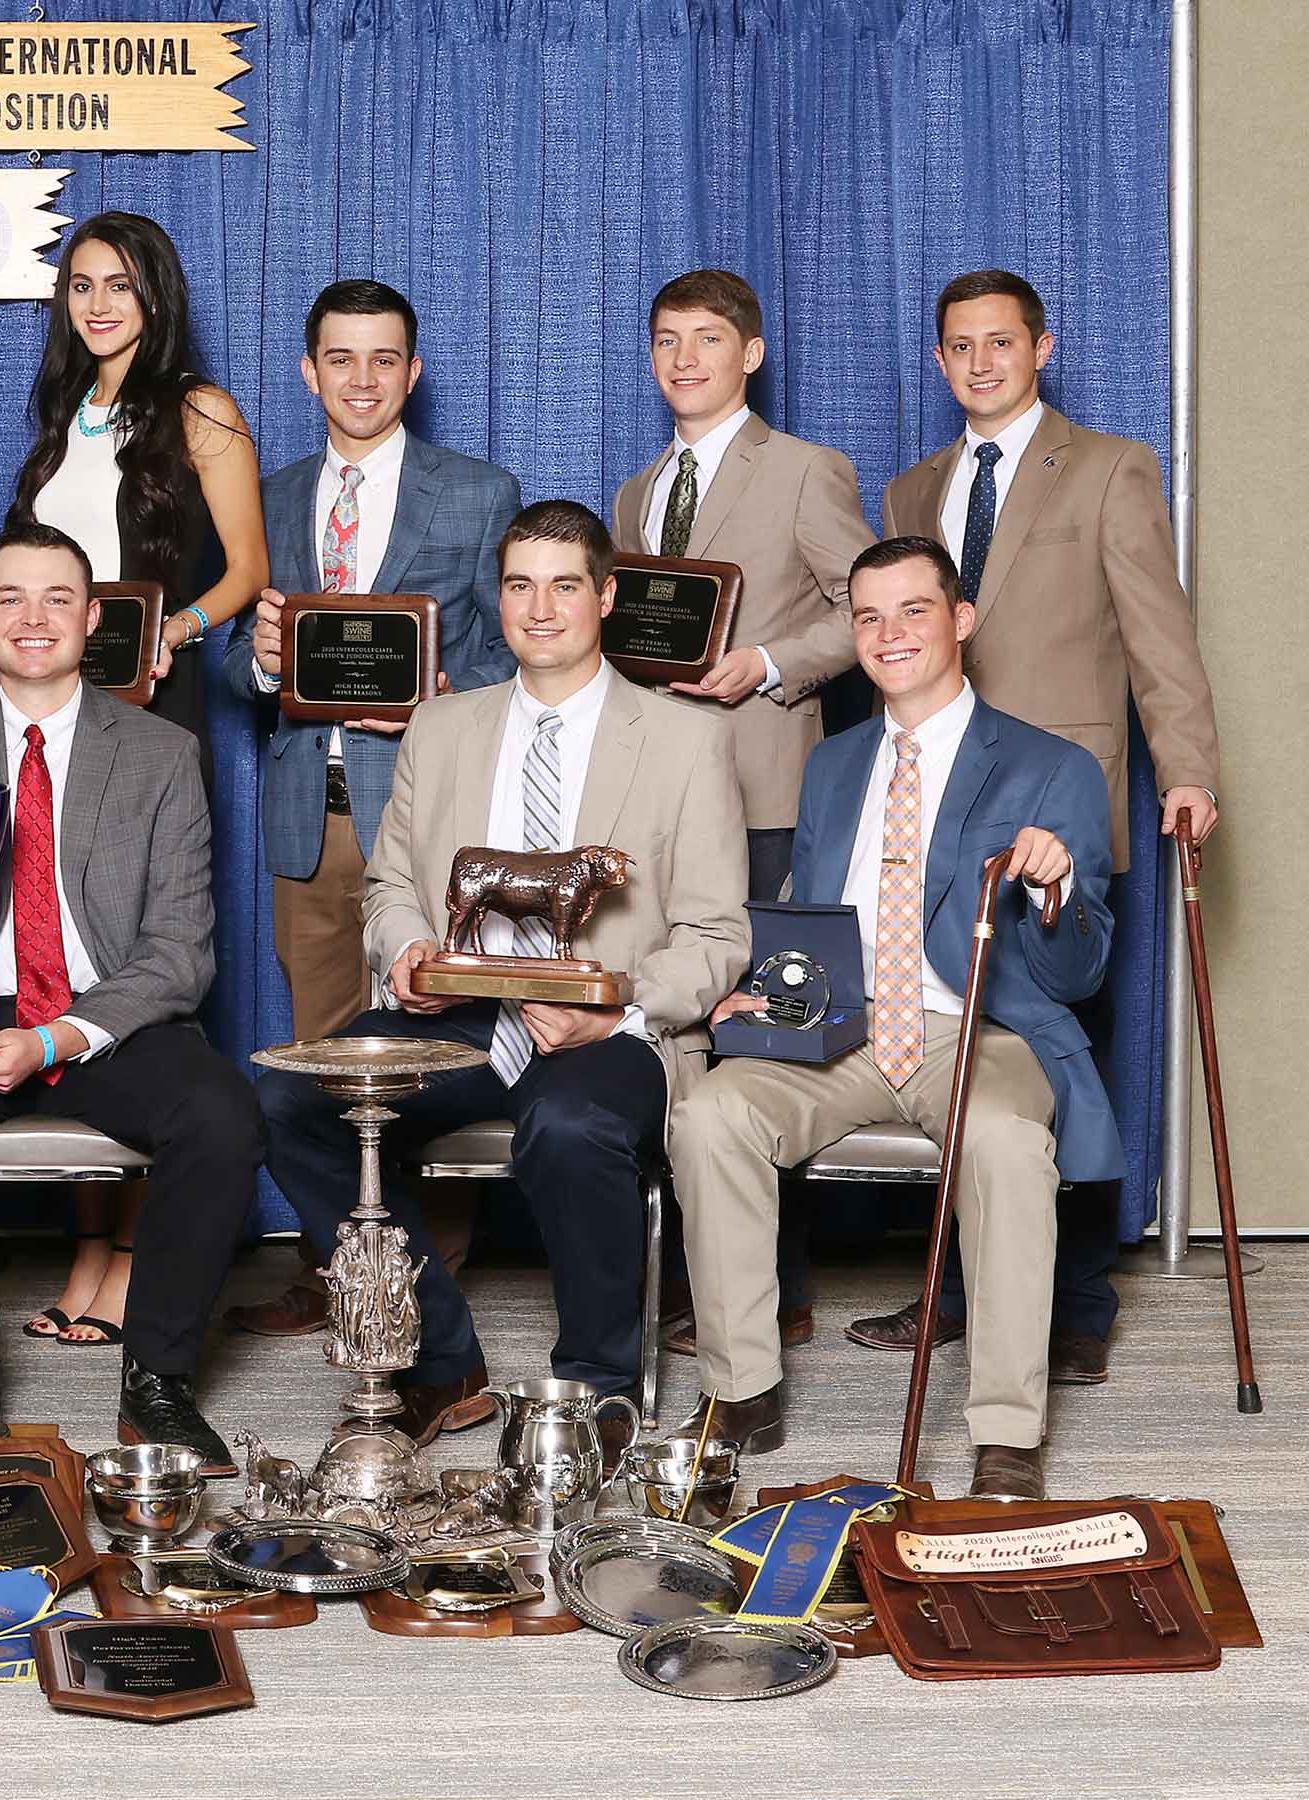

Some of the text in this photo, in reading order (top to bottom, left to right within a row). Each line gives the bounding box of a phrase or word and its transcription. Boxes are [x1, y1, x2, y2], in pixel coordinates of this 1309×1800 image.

[964, 1537, 993, 1546] 2020
[996, 1529, 1071, 1544] Intercollegiate
[922, 1532, 1122, 1563] High Individual
[1030, 1552, 1065, 1566] ANGUS
